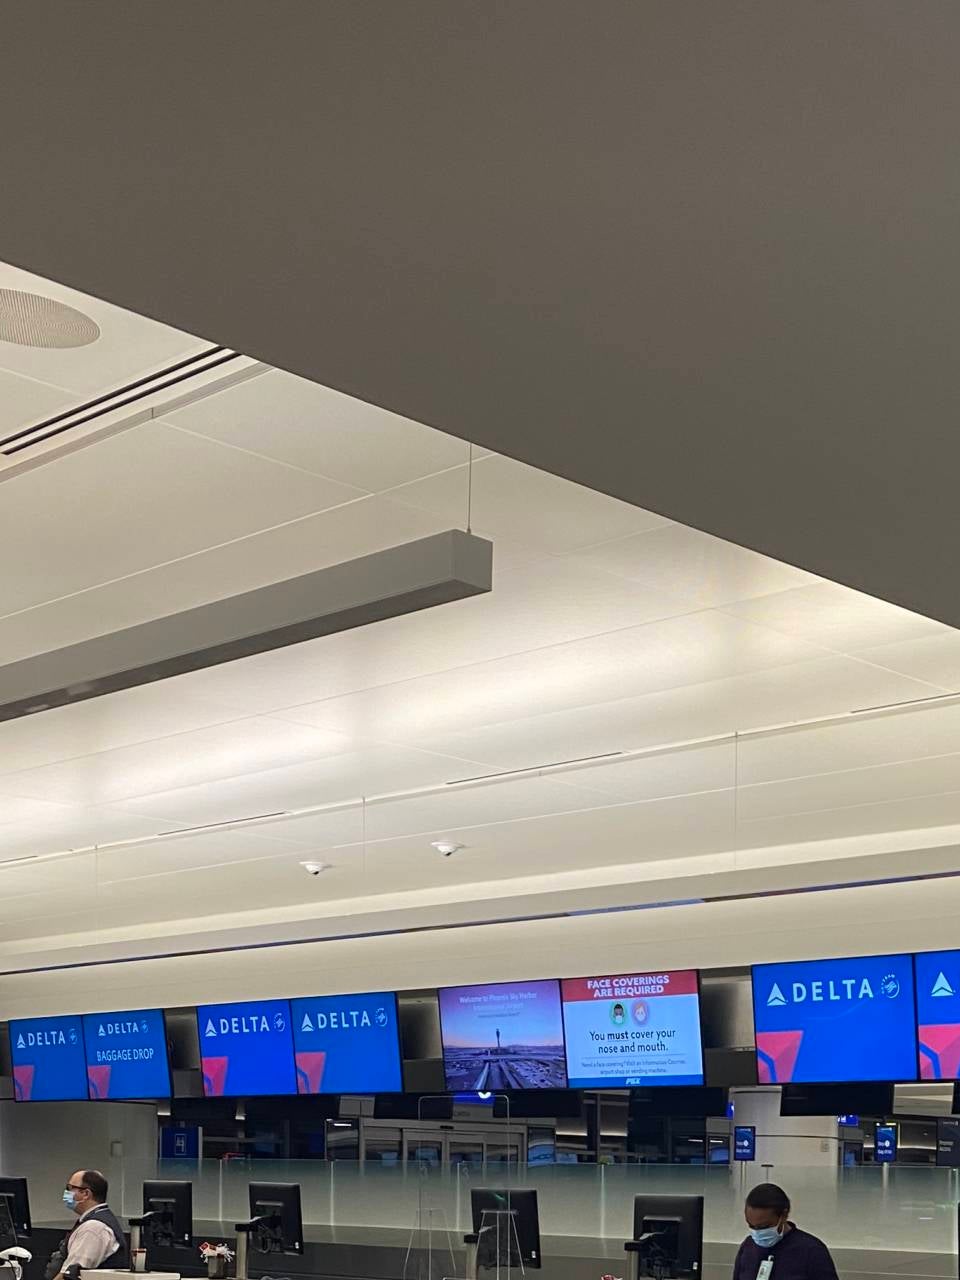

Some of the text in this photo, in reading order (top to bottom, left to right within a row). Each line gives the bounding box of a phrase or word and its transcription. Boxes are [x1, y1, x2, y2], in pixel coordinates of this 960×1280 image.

[587, 975, 669, 989] FACE COVERINGS
[594, 985, 664, 998] ARE REQUIRED
[793, 978, 874, 1002] DELTA
[220, 1015, 270, 1034] DELTA
[318, 1010, 371, 1029] DELTA
[108, 1022, 139, 1035] DELTA
[590, 1030, 676, 1041] You must cover your
[28, 1030, 66, 1046] DELTA
[598, 1041, 669, 1054] nose and mouth.
[97, 1048, 154, 1062] BAGGAGE DROP
